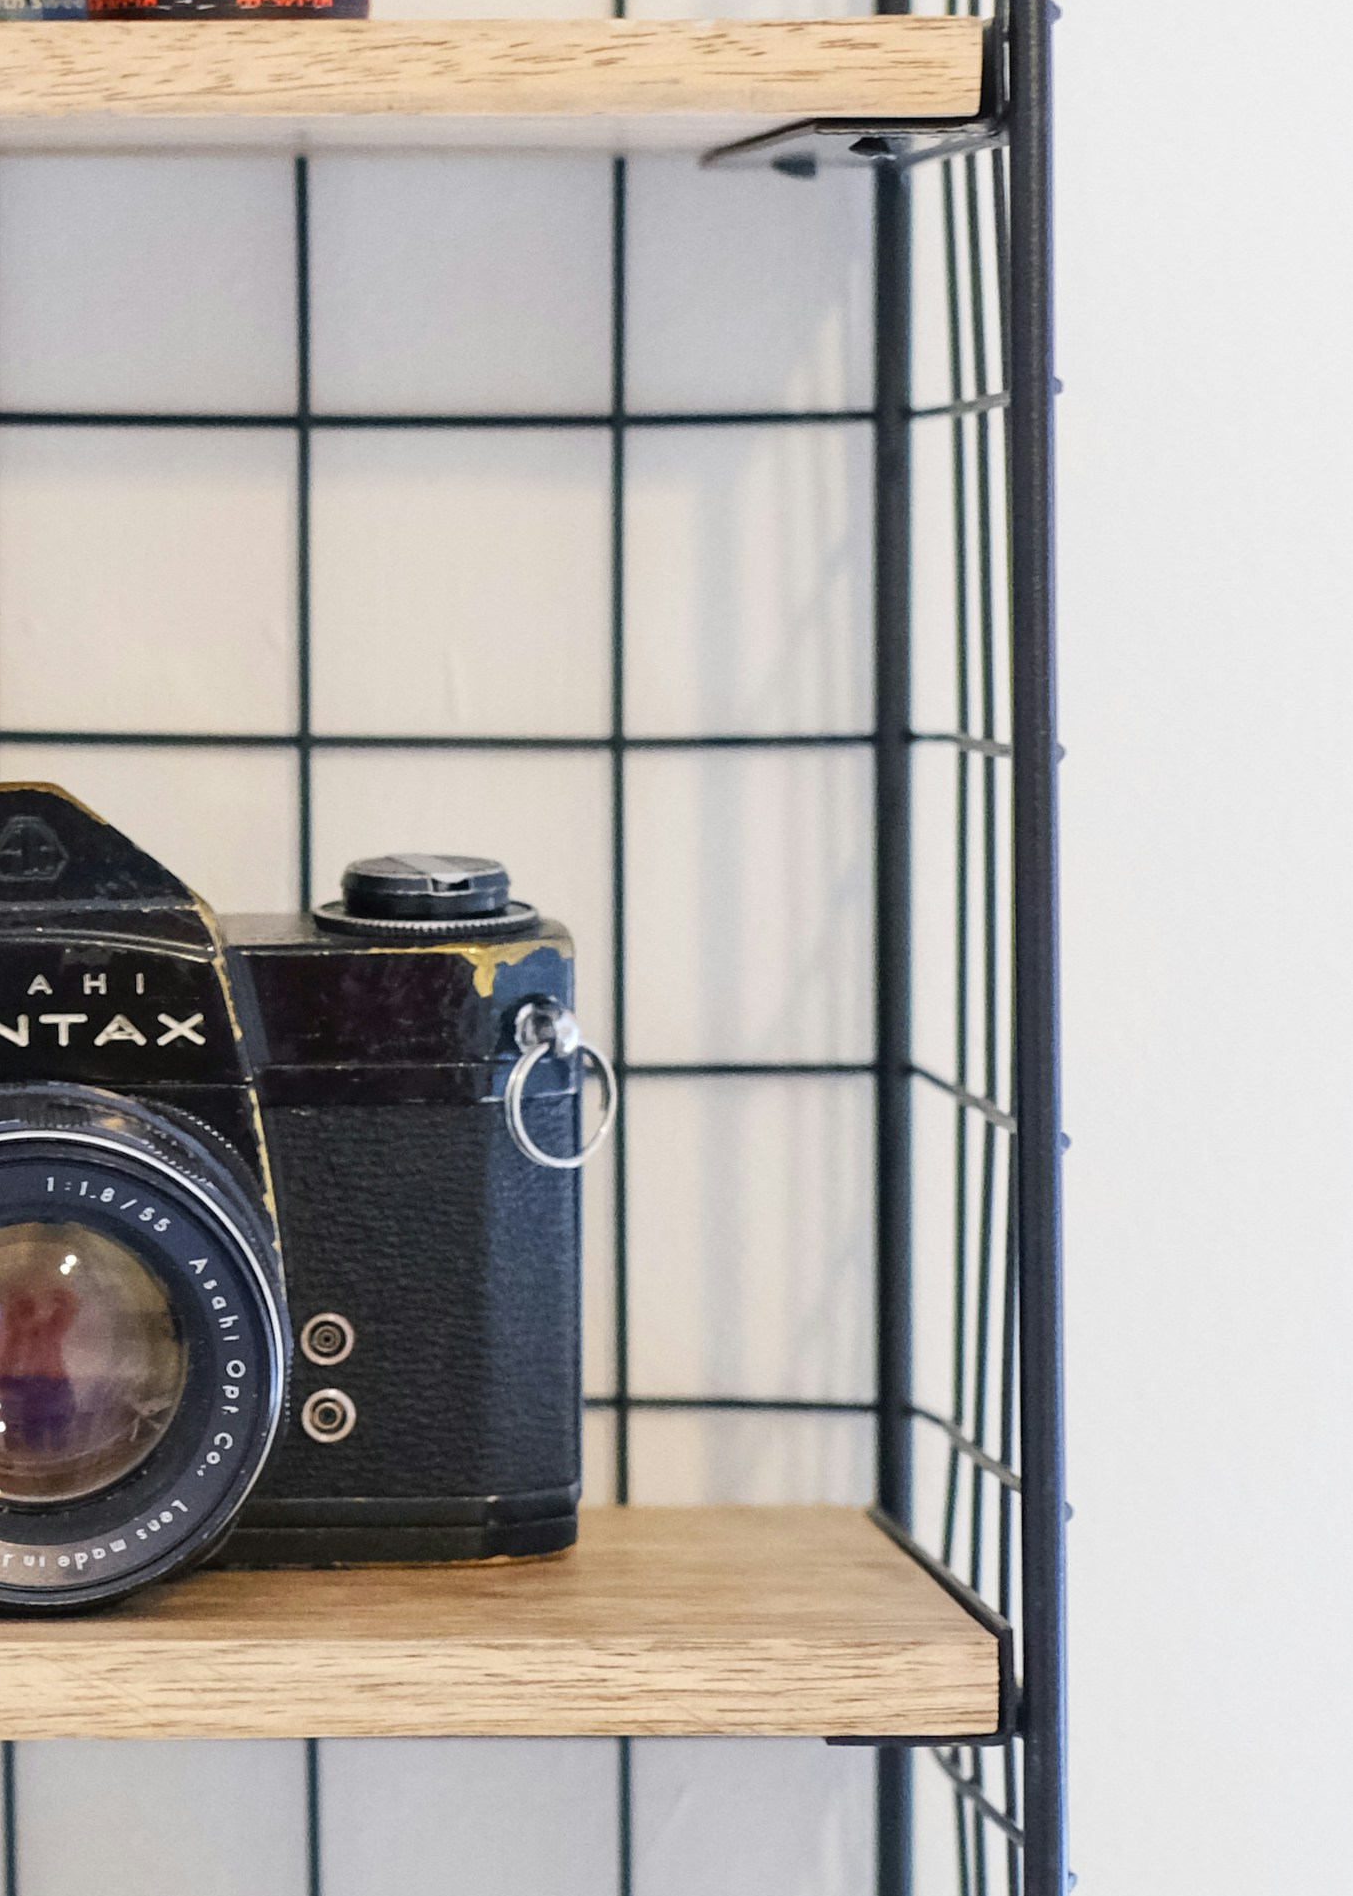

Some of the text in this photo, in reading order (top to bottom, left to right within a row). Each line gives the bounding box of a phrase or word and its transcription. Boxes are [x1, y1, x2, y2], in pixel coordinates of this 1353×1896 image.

[188, 1257, 240, 1344] Asahi
[135, 1499, 189, 1540] Lens
[22, 1553, 47, 1569] in
[56, 1538, 126, 1570] made
